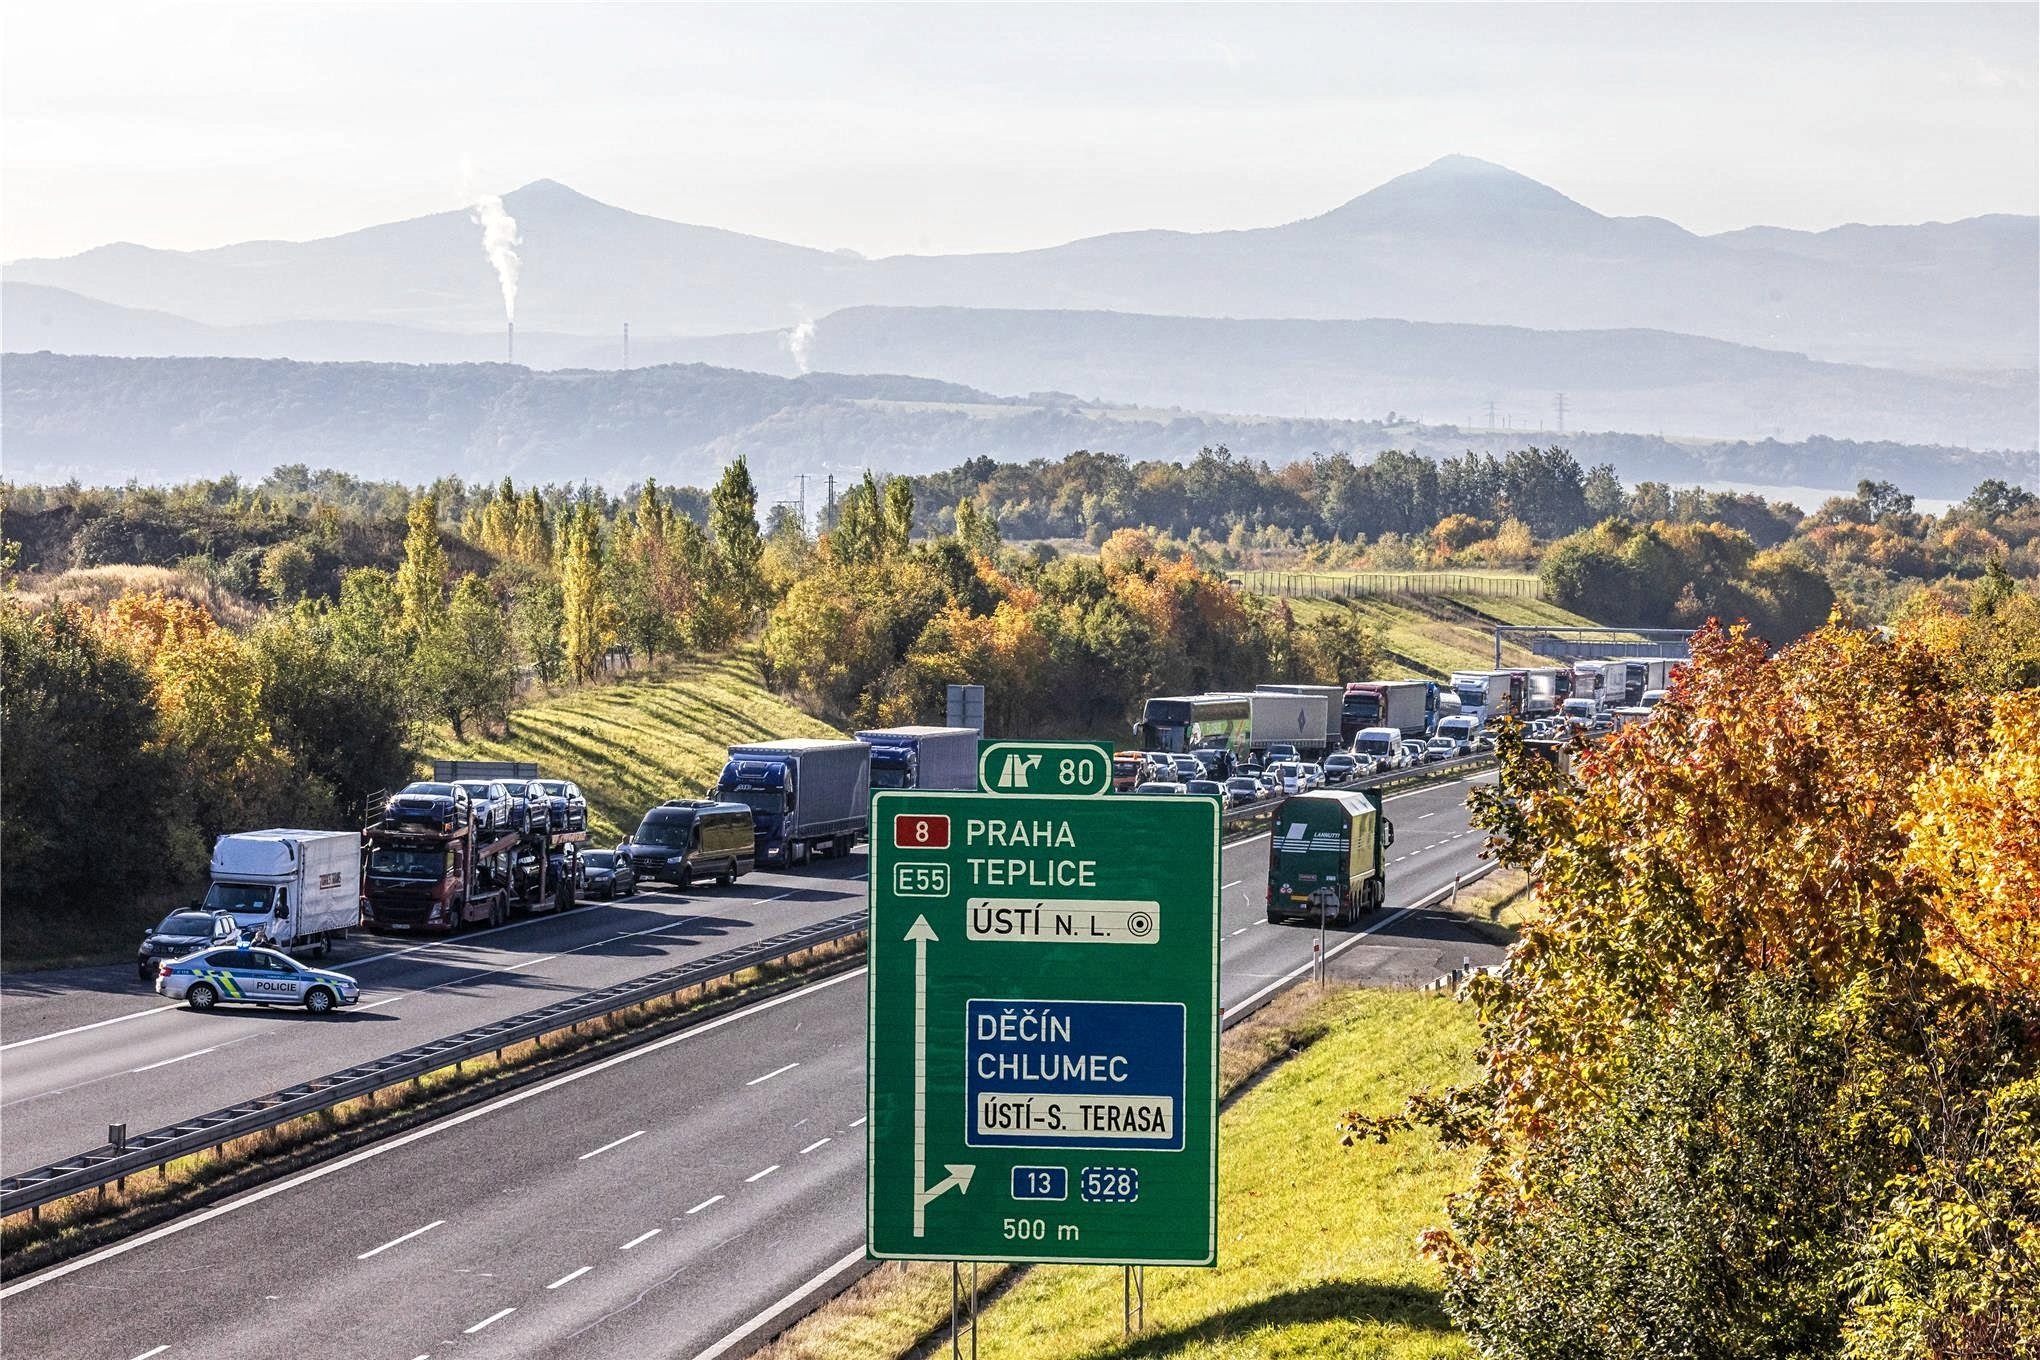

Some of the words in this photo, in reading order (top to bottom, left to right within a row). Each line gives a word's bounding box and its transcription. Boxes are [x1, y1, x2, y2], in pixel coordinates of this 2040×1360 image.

[1059, 759, 1094, 785] 80
[915, 821, 929, 842] 8
[967, 819, 1076, 848] PRAHA
[899, 869, 945, 891] E55
[967, 859, 1097, 887] TEPLICE
[973, 902, 1044, 935] ÚSTÍ
[1055, 915, 1078, 936] N.
[1091, 916, 1111, 937] L.
[256, 981, 297, 992] POLICIE
[977, 1008, 1072, 1042] DĚČÍN
[977, 1053, 1129, 1083] CHLUMEC
[984, 1096, 1066, 1131] ÚSTÍ-S.
[1079, 1105, 1166, 1133] TERASA
[1027, 1173, 1051, 1194] 13
[1088, 1173, 1131, 1196] 528
[1003, 1219, 1046, 1241] 500
[1057, 1223, 1080, 1241] m
